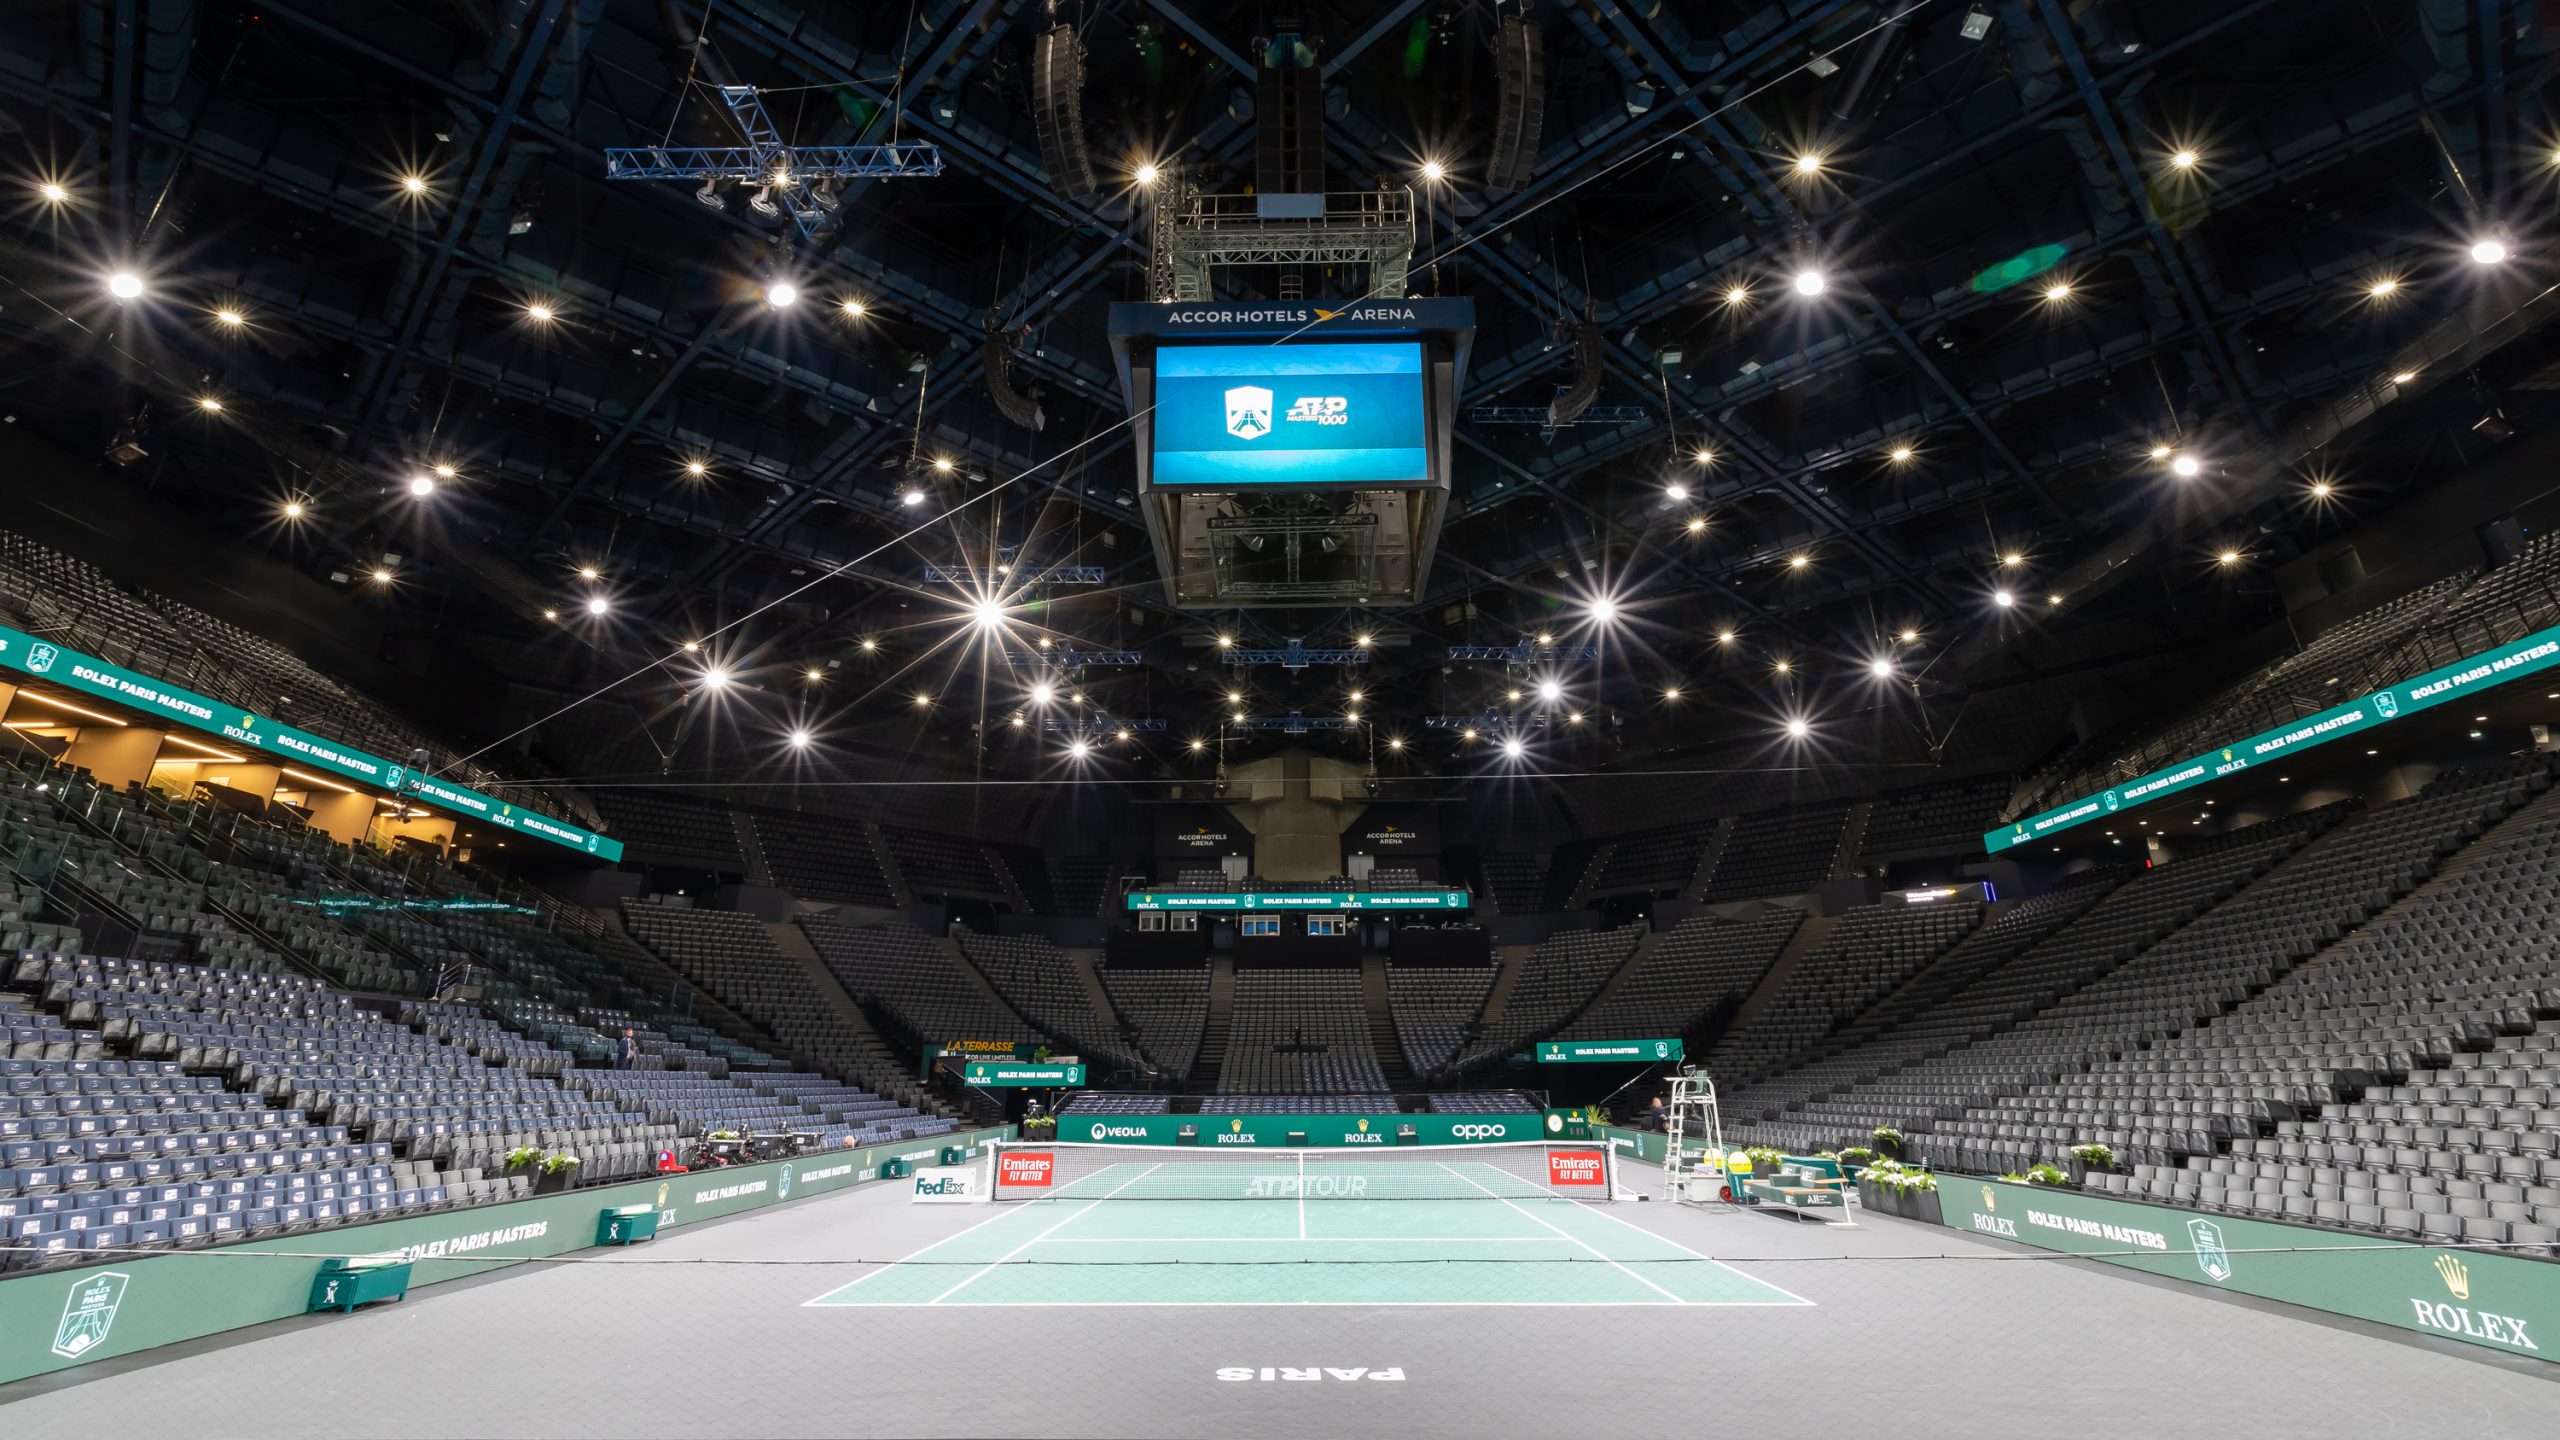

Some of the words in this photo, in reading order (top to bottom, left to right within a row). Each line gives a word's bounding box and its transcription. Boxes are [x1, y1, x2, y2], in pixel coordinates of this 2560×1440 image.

[1351, 308, 1416, 321] ARENA
[1285, 396, 1347, 415] ATP
[1318, 414, 1348, 425] 1000
[2410, 679, 2453, 700] ROLEX
[2453, 665, 2493, 687] PARIS
[2491, 641, 2560, 673] MASTERS
[72, 665, 119, 688] ROLEX
[119, 681, 157, 701] PARIS
[157, 694, 213, 720] MASTERS
[223, 725, 262, 744] ROLEX
[2254, 737, 2286, 754] ROLEX
[2286, 727, 2315, 744] PARIS
[2314, 710, 2363, 735] MASTERS
[277, 735, 310, 753] ROLEX
[310, 746, 337, 762] PARIS
[337, 756, 377, 775] MASTERS
[2216, 759, 2248, 775] ROLEX
[2124, 785, 2148, 799] ROLEX
[2147, 778, 2169, 792] PARIS
[2168, 766, 2204, 784] MASTERS
[435, 787, 456, 801] PARIS
[456, 794, 487, 811] MASTERS
[492, 813, 515, 827] ROLEX
[2035, 819, 2054, 830] ROLEX
[2053, 812, 2071, 824] PARIS
[2070, 803, 2099, 818] MASTERS
[523, 818, 543, 830] ROLEX
[543, 824, 560, 836] PARIS
[559, 830, 583, 843] MASTERS
[2012, 832, 2031, 844] ROLEX
[946, 1040, 961, 1051] LA
[962, 1040, 1015, 1052] TERRASSE
[1107, 1126, 1147, 1138] VEOLIA
[1217, 1133, 1256, 1143] ROLEX
[1344, 1133, 1382, 1143] ROLEX
[1452, 1124, 1506, 1140] oppo
[1003, 1157, 1050, 1171] Emirates
[1551, 1156, 1600, 1170] Emirates
[801, 1170, 817, 1183] ROLEX
[818, 1168, 831, 1179] PARIS
[831, 1164, 852, 1177] MASTERS
[858, 1168, 876, 1181] ROLEX
[1009, 1171, 1020, 1181] FLY
[1020, 1171, 1043, 1181] BETTER
[1560, 1170, 1572, 1180] FLY
[1572, 1170, 1594, 1180] BETTER
[695, 1188, 718, 1204] ROLEX
[719, 1185, 739, 1200] PARIS
[739, 1180, 767, 1197] MASTERS
[915, 1177, 964, 1195] FedEx
[1973, 1212, 2017, 1237] ROLEX
[2027, 1209, 2066, 1231] ROLEX
[2065, 1216, 2102, 1238] PARIS
[2102, 1223, 2167, 1250] MASTERS
[449, 1231, 490, 1254] PARIS
[490, 1221, 548, 1246] MASTERS
[2411, 1298, 2540, 1350] ROLEX
[1215, 1366, 1407, 1382] PARIS
